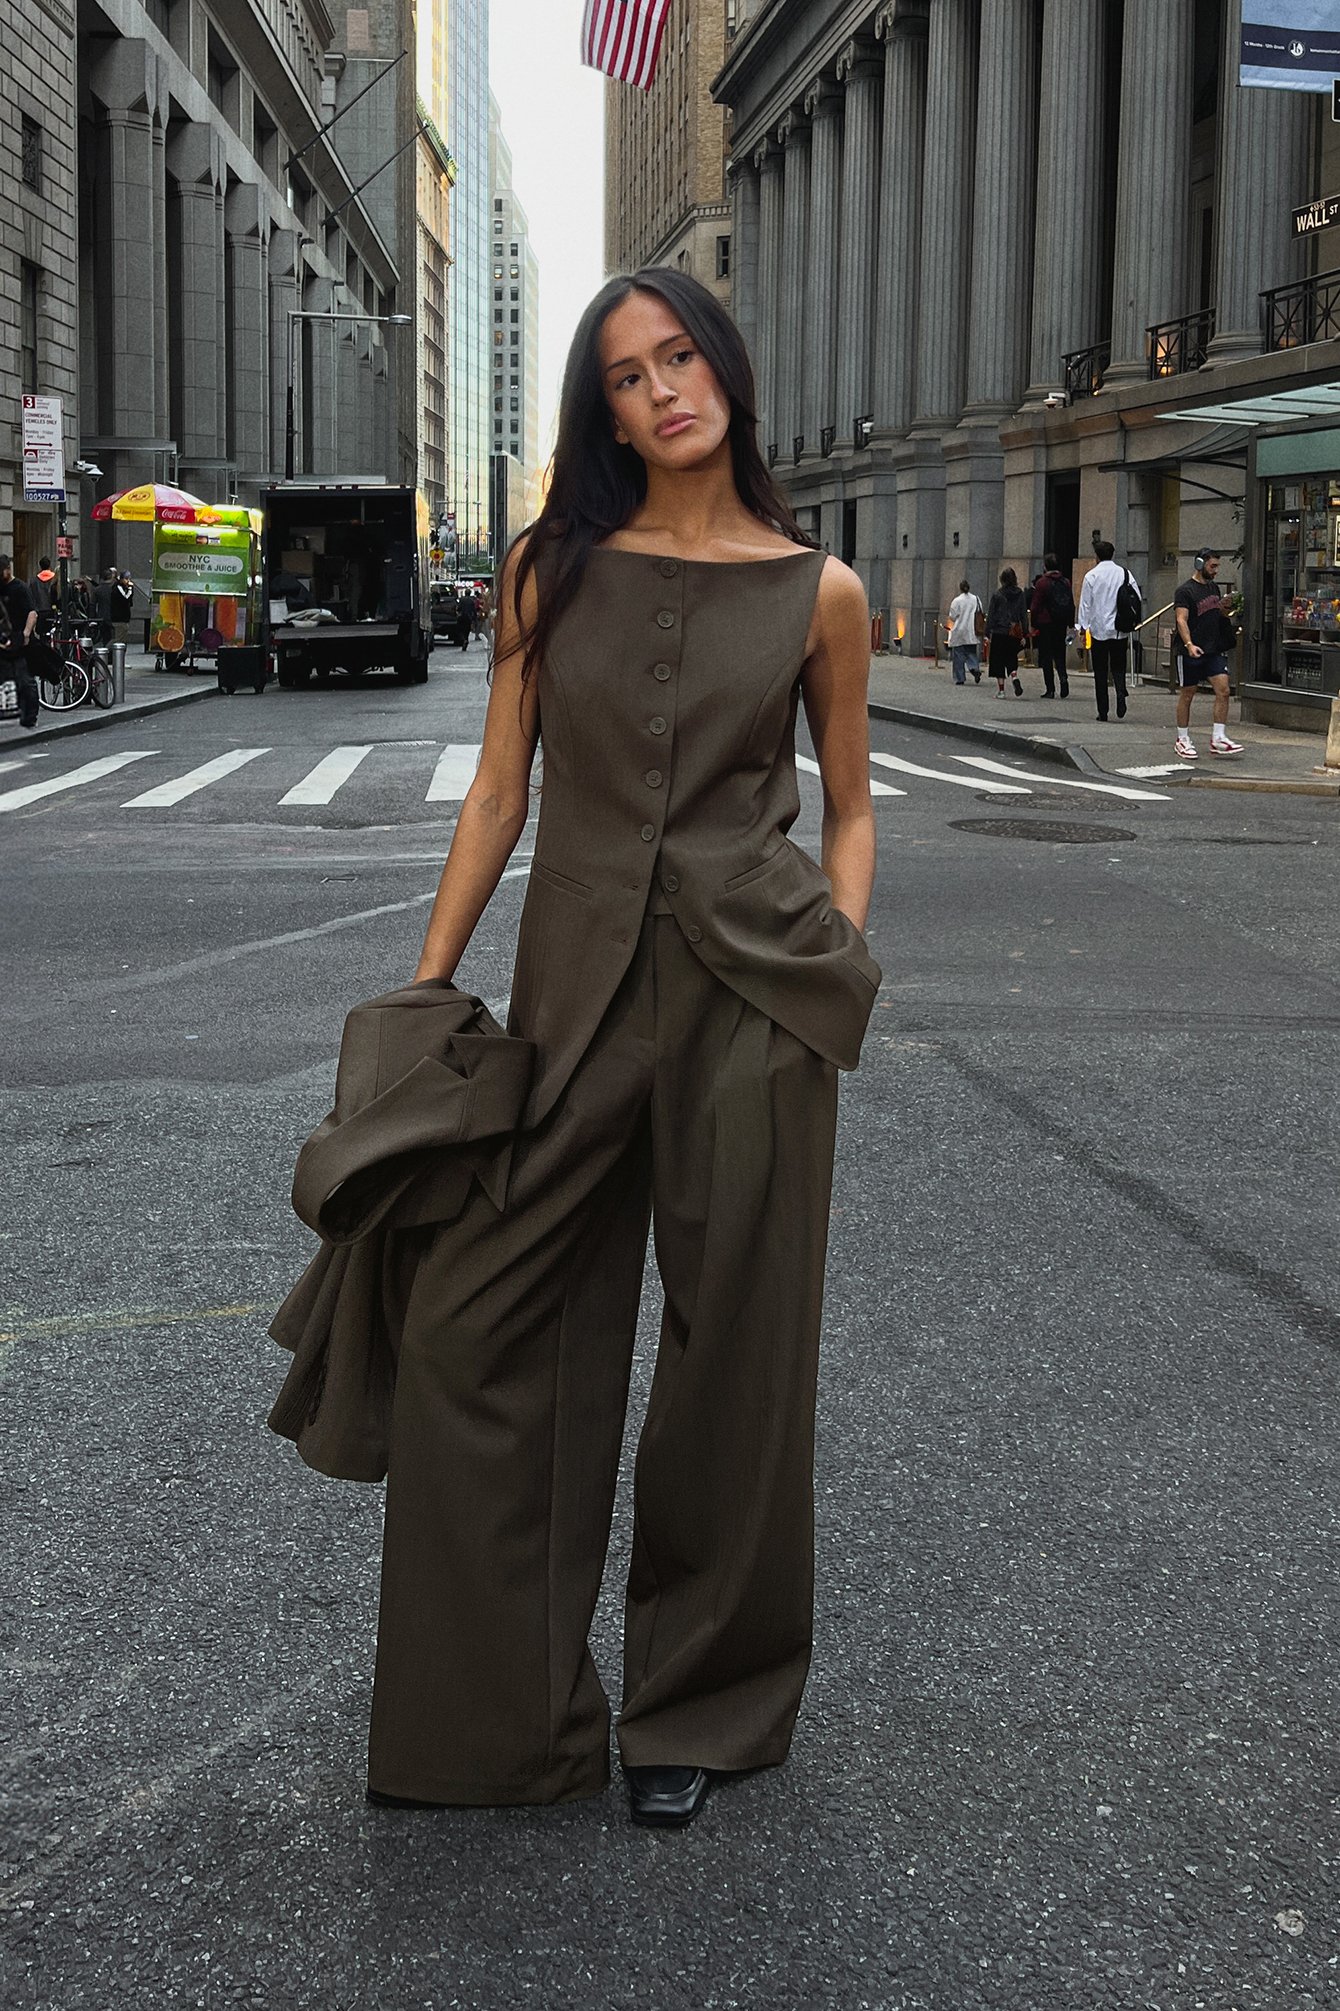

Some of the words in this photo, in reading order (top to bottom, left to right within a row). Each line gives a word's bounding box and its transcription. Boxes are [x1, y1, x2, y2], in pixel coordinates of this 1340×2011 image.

[1297, 209, 1329, 232] WALL
[1329, 204, 1339, 215] ST
[26, 397, 33, 408] 3
[189, 554, 211, 564] NYC
[164, 561, 206, 571] SMOOTHIE
[214, 565, 238, 573] JUICE
